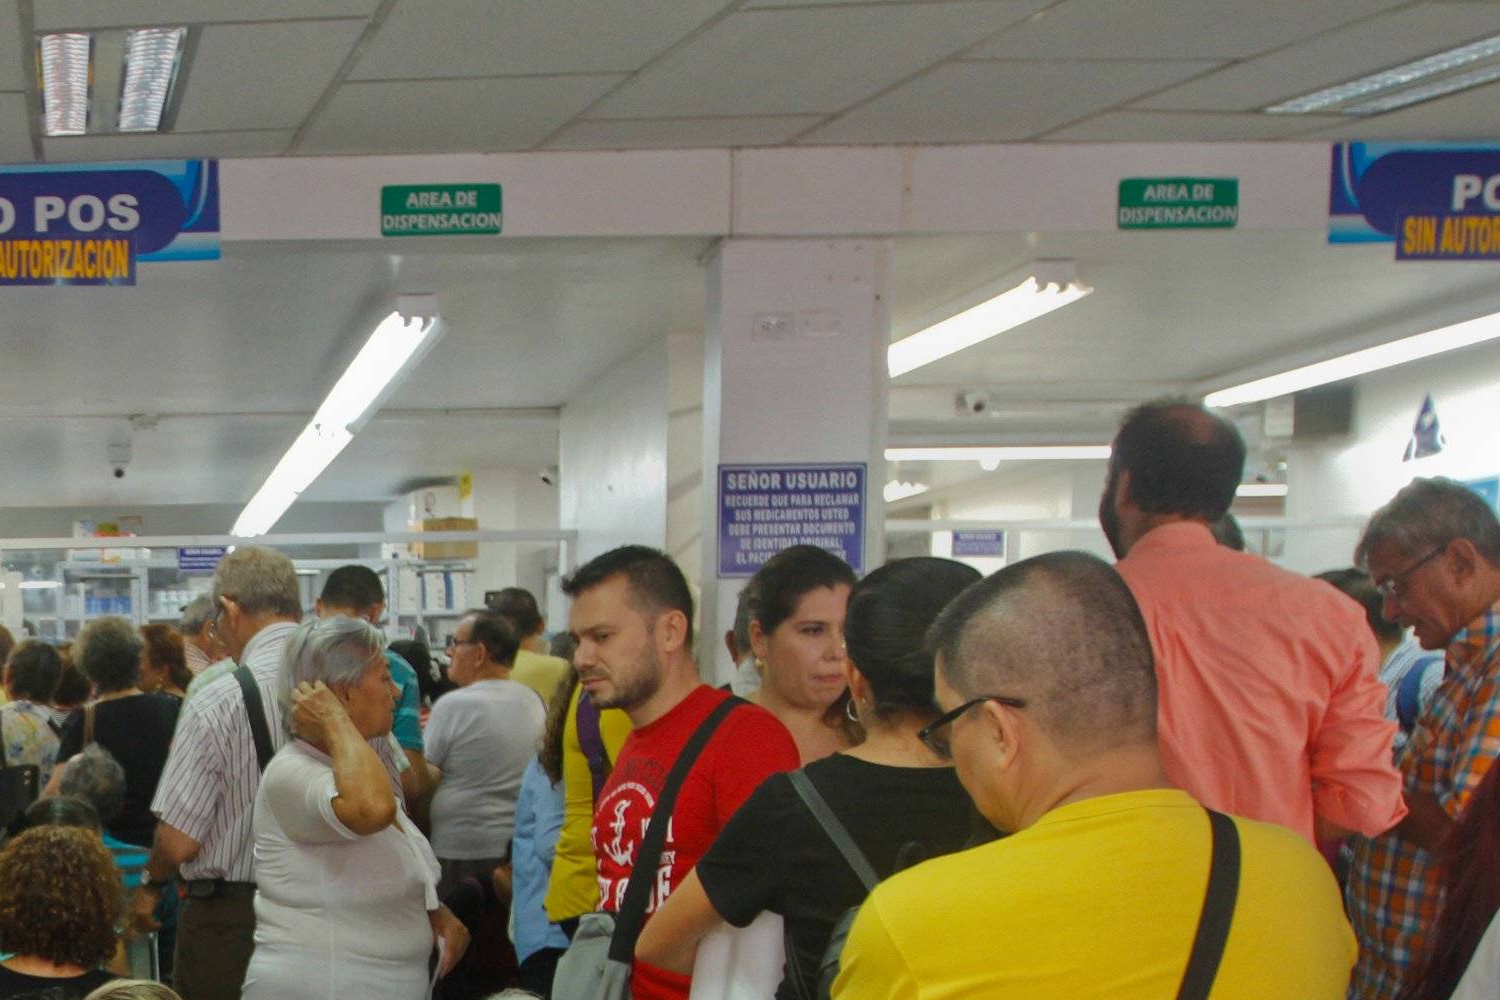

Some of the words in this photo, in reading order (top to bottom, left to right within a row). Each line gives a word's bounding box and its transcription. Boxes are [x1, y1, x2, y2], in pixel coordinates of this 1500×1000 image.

[406, 191, 452, 208] AREA
[455, 190, 478, 206] DE
[1143, 184, 1189, 200] AREA
[1192, 184, 1215, 200] DE
[33, 194, 141, 233] POS
[382, 212, 501, 229] DISPENSACION
[1119, 206, 1238, 224] DISPENSACION
[1403, 215, 1438, 255] SIN
[727, 470, 781, 490] SEÑOR
[786, 471, 857, 489] USUARIO
[725, 494, 769, 507] RECUERDE
[772, 494, 788, 506] QUE
[791, 493, 812, 506] PARA
[815, 492, 859, 506] RECLAMAR
[735, 509, 751, 521] SUS
[753, 508, 819, 521] MEDICAMENTOS
[822, 507, 849, 520] USTED
[803, 521, 856, 535] DOCUMENTO
